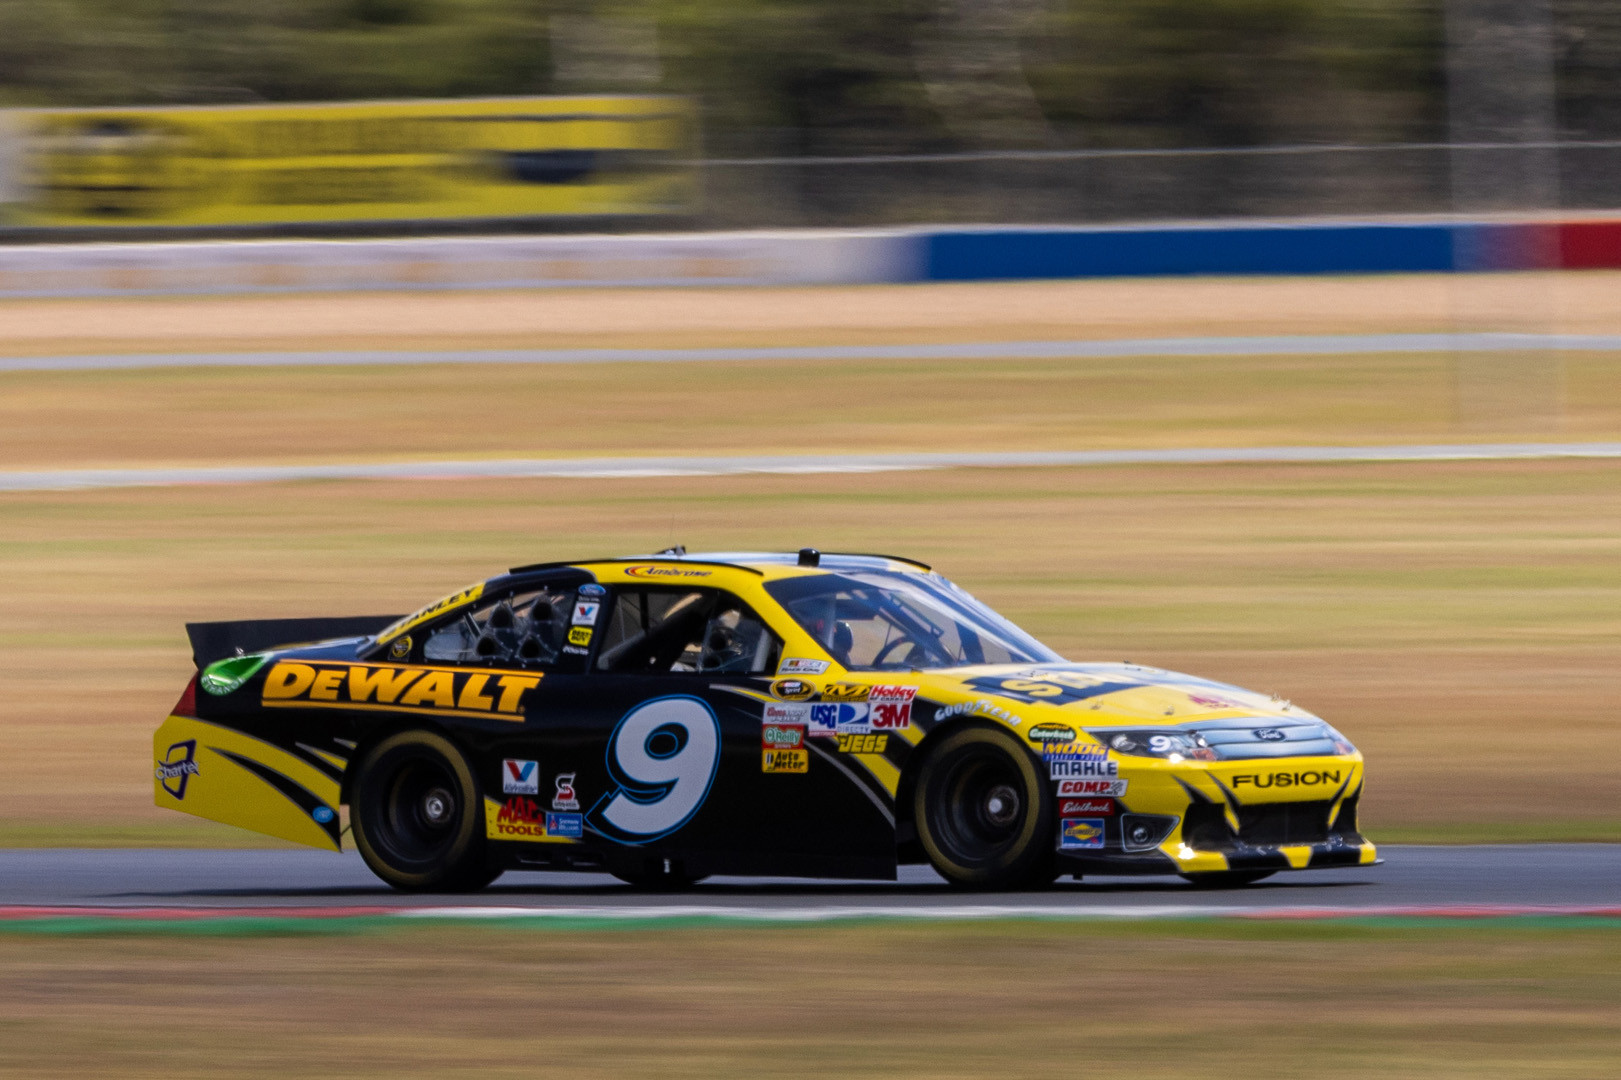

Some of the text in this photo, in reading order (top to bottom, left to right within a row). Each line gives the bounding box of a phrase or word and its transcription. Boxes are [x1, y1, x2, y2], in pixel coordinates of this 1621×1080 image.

[810, 704, 837, 729] USG
[872, 704, 911, 728] 3M
[934, 699, 1022, 727] GOODYEAR
[838, 734, 889, 753] JEGS
[1044, 743, 1107, 755] MOOG
[1148, 735, 1171, 752] 9
[155, 761, 199, 781] Charter
[599, 695, 721, 843] 9
[1052, 761, 1117, 776] MAHLE
[1061, 781, 1111, 794] COMP
[1232, 770, 1341, 790] FUSION
[497, 796, 543, 824] MAC
[497, 823, 543, 836] TOOLS
